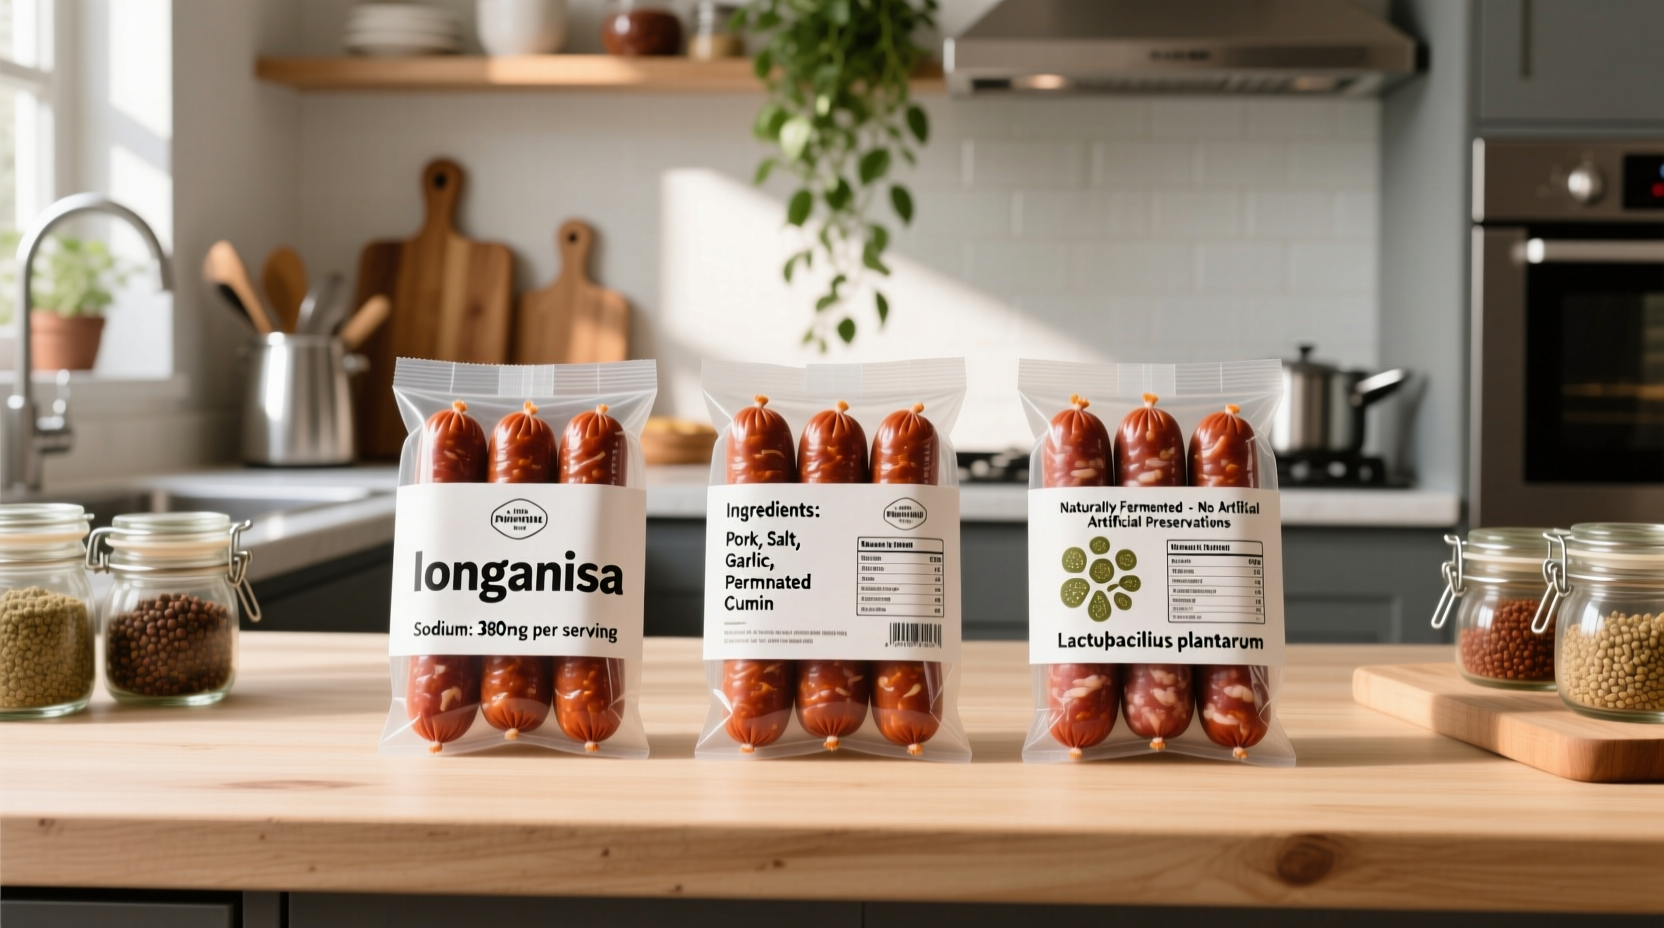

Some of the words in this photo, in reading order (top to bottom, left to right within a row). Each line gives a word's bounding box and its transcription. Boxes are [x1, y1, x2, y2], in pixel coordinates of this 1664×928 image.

[726, 501, 820, 522] Ingredients:
[1060, 501, 1117, 516] Naturally
[1119, 500, 1183, 515] Fermented
[1198, 502, 1215, 514] No
[726, 531, 763, 550] Pork,
[767, 530, 801, 551] Salt,
[725, 552, 775, 571] Garlic,
[725, 573, 812, 590] Permnated
[724, 595, 774, 611] Cumin
[413, 620, 473, 637] Sodium:
[533, 624, 557, 641] per
[562, 622, 618, 643] serving
[1178, 630, 1264, 652] plantarum
